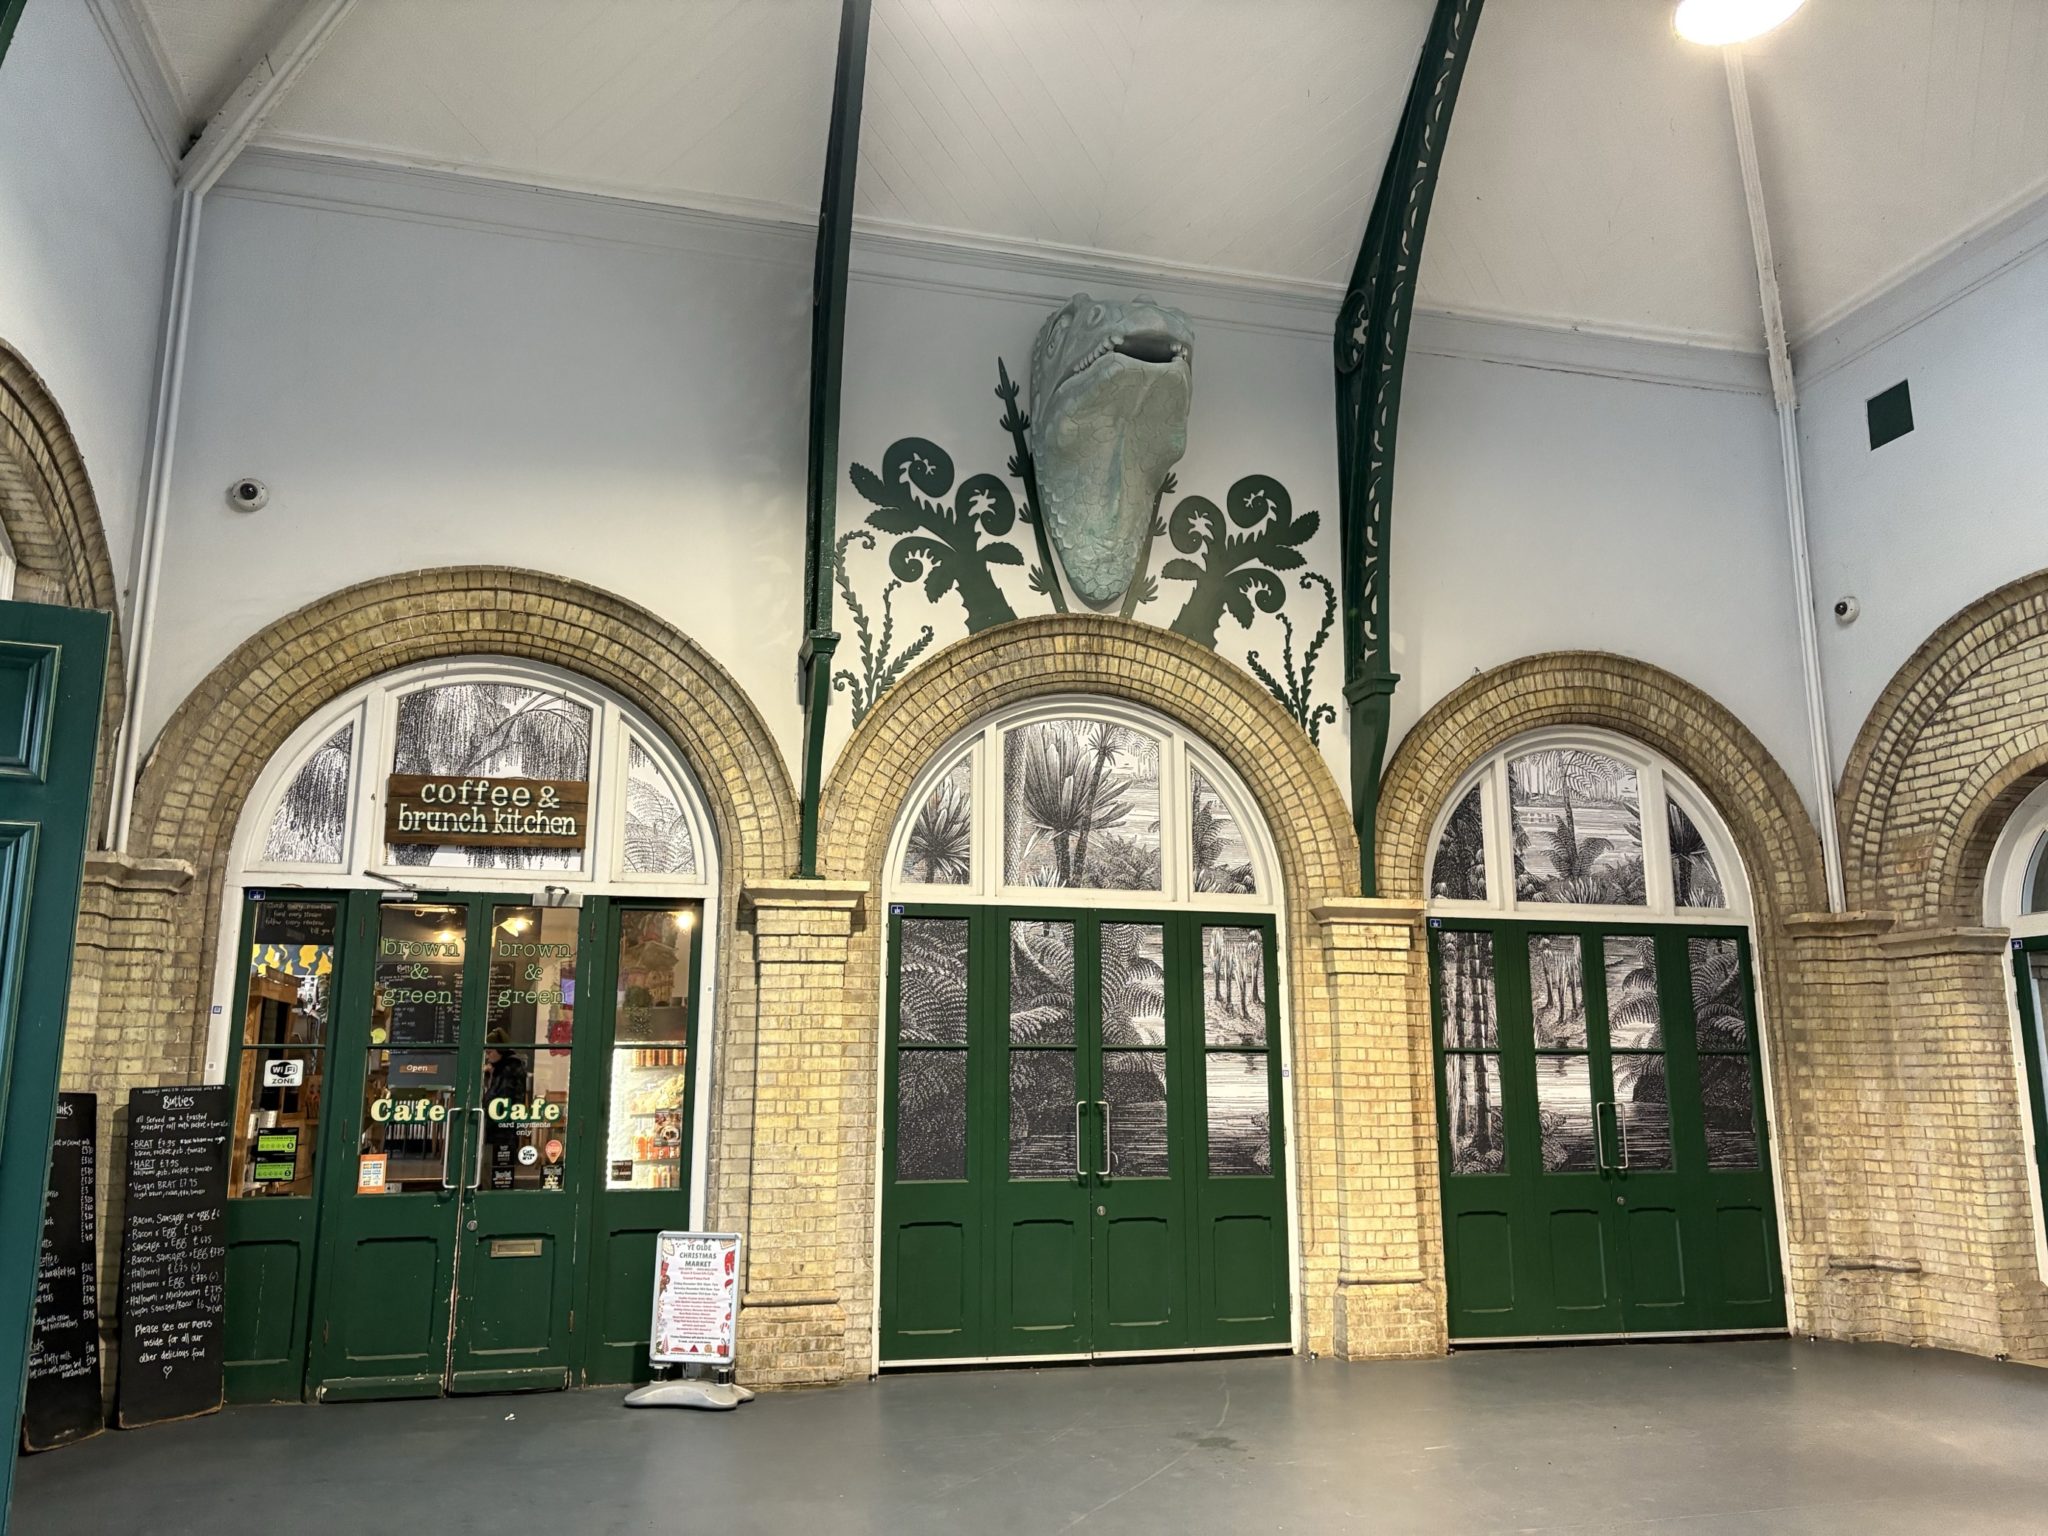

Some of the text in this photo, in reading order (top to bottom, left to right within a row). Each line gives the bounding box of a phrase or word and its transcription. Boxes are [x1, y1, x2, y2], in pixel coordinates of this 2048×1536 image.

[421, 780, 560, 808] coffee &
[398, 804, 577, 835] brunch kitchen
[383, 937, 460, 957] brown
[500, 939, 572, 957] brown
[410, 963, 429, 979] &
[525, 963, 543, 980] &
[381, 988, 453, 1007] green
[497, 989, 567, 1008] green
[406, 1065, 428, 1073] Open
[162, 1094, 195, 1109] Butties
[371, 1098, 446, 1122] Cafe
[488, 1097, 560, 1121] Cafe
[134, 1139, 154, 1149] BRAT
[157, 1180, 176, 1189] BRAT
[135, 1324, 159, 1338] Please
[162, 1322, 175, 1332] see
[143, 1337, 164, 1347] inside
[168, 1334, 179, 1347] for
[139, 1353, 157, 1363] other
[161, 1348, 189, 1360] delicious
